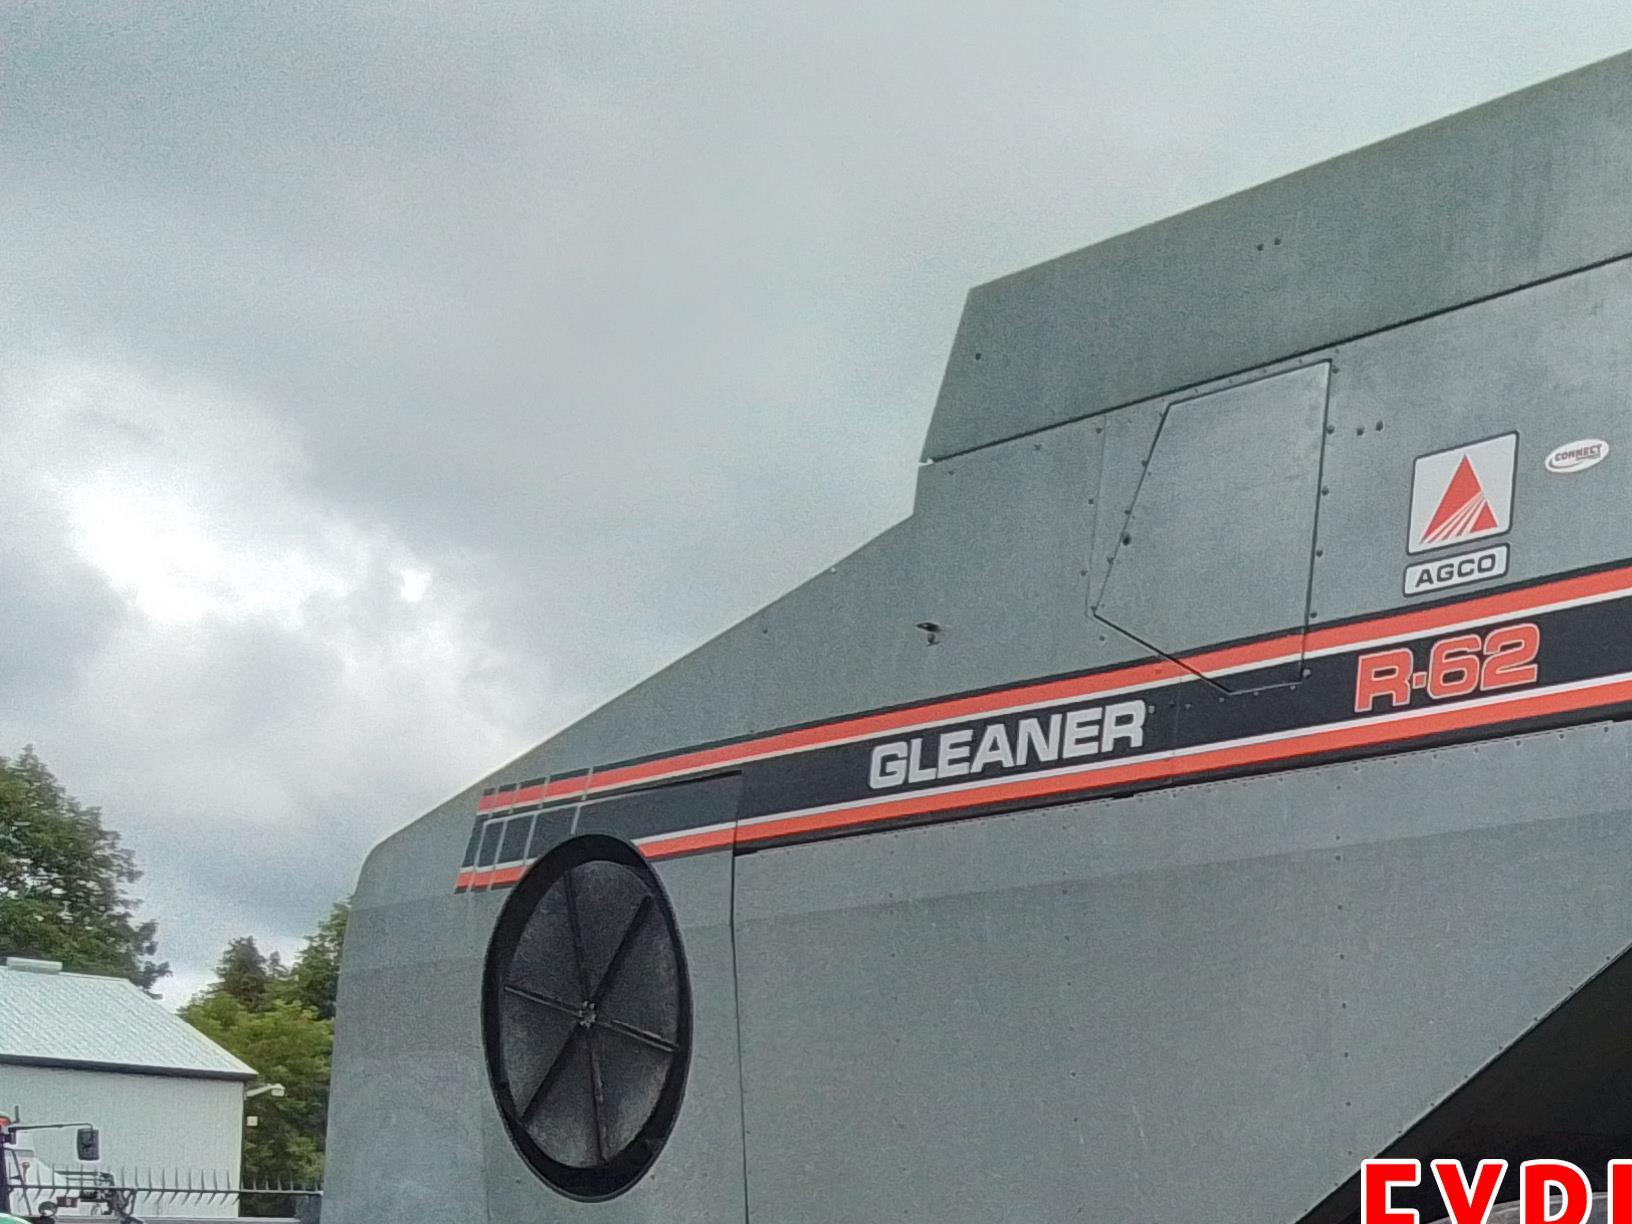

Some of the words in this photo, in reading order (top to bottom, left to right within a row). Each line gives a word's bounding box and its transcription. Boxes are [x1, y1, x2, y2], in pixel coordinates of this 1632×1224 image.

[1554, 443, 1602, 462] CONNECT
[1414, 553, 1497, 588] AGCO
[868, 699, 1147, 790] GLEANER
